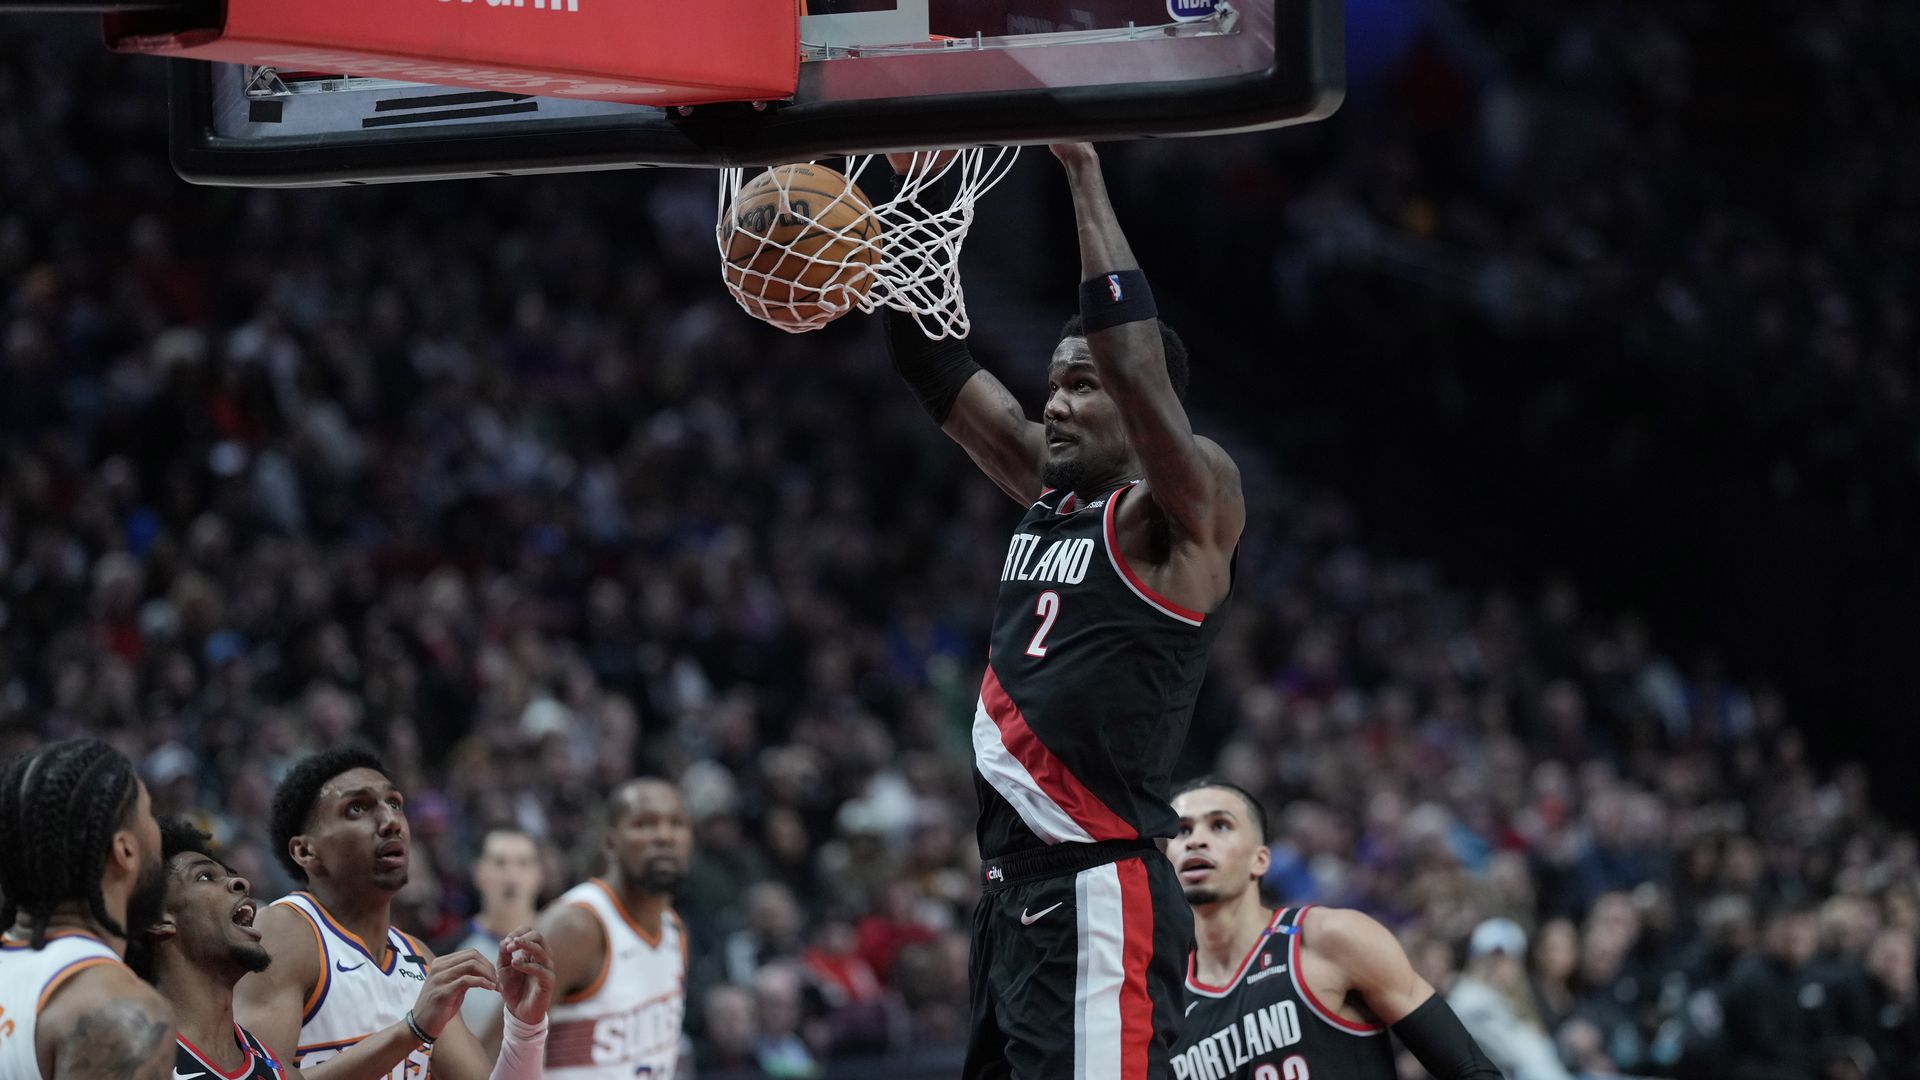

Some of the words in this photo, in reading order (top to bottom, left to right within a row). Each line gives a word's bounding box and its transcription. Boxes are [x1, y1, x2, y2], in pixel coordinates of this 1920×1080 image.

[1000, 532, 1095, 585] RTLAND
[1025, 590, 1060, 659] 2
[1169, 999, 1303, 1080] PORTLAND
